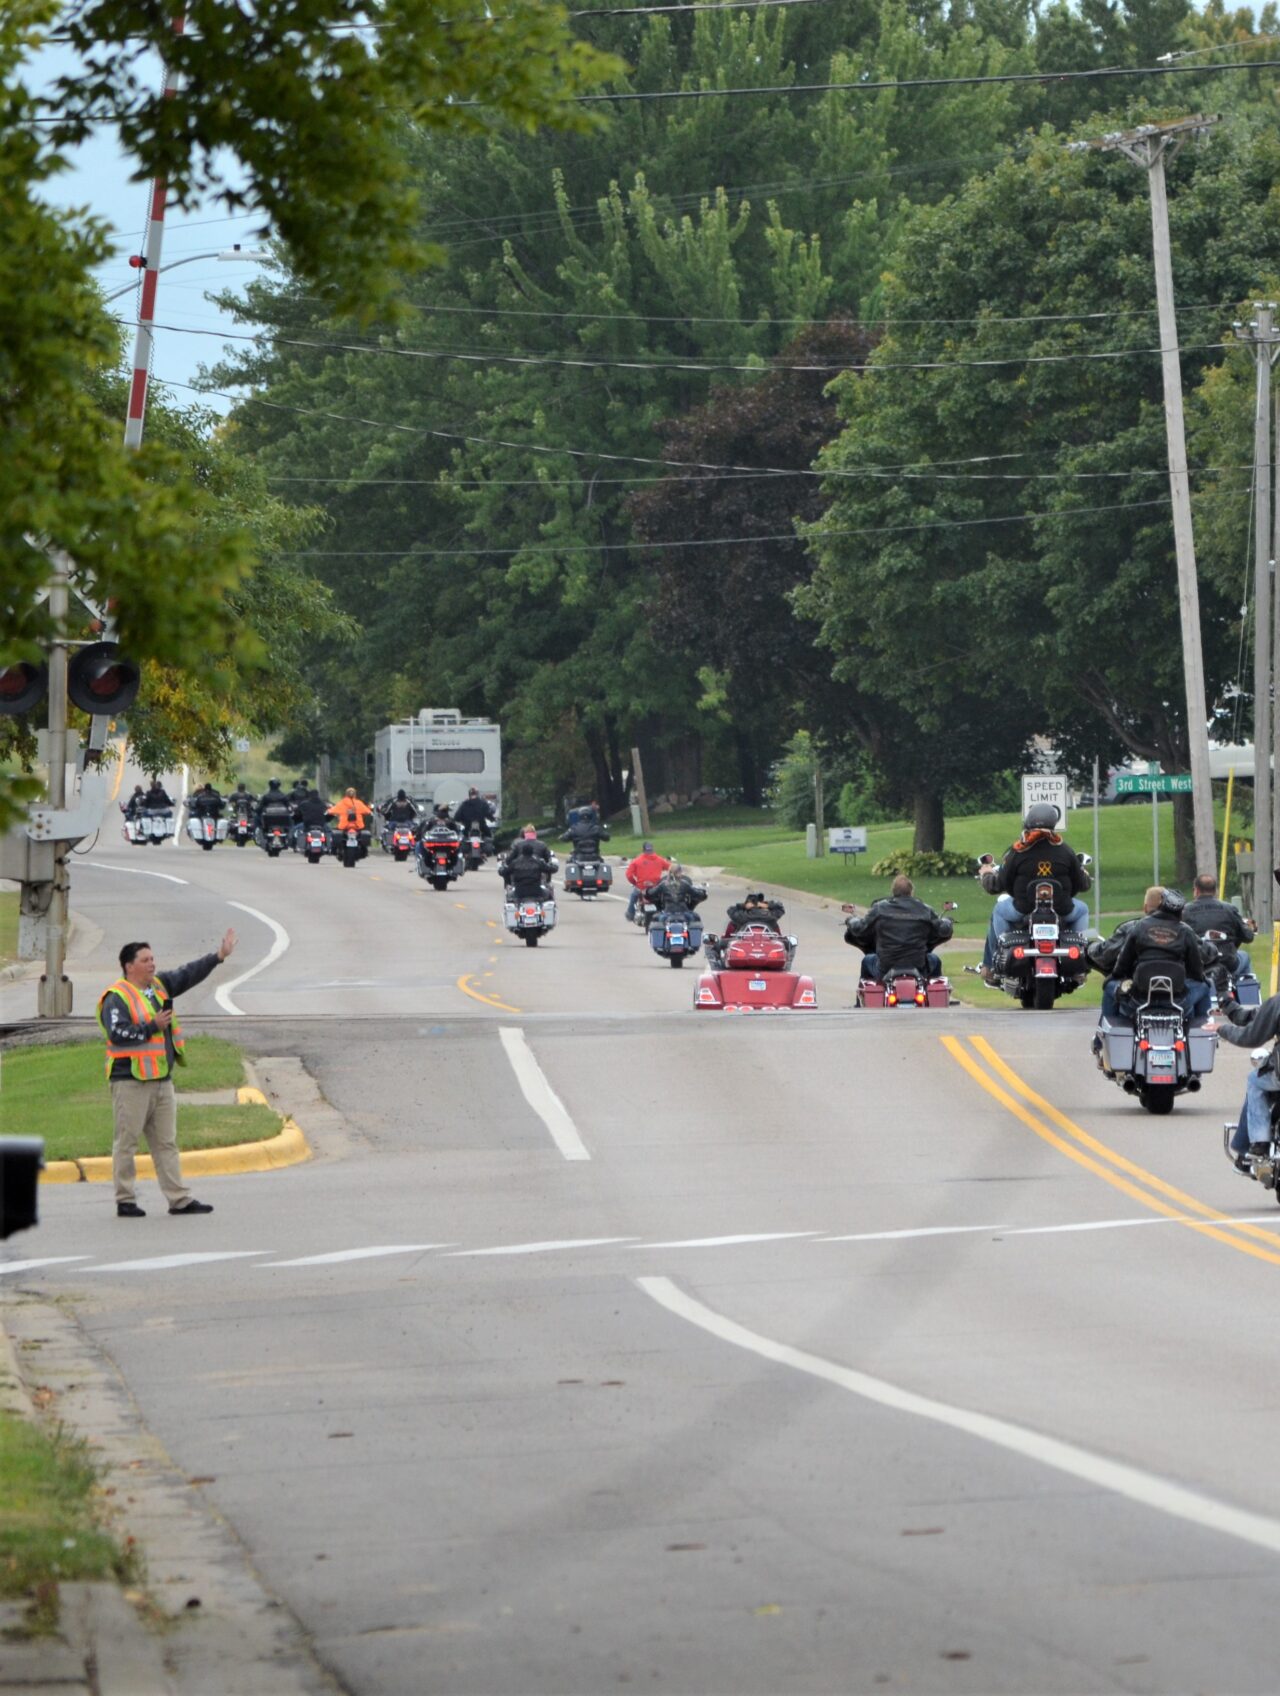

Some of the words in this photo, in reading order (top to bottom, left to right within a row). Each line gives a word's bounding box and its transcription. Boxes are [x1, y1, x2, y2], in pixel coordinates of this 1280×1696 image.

[1026, 782, 1063, 791] SPEED
[1118, 779, 1133, 791] 3rd
[1139, 779, 1165, 790] Street
[1171, 778, 1192, 790] West
[1030, 793, 1058, 802] LIMIT
